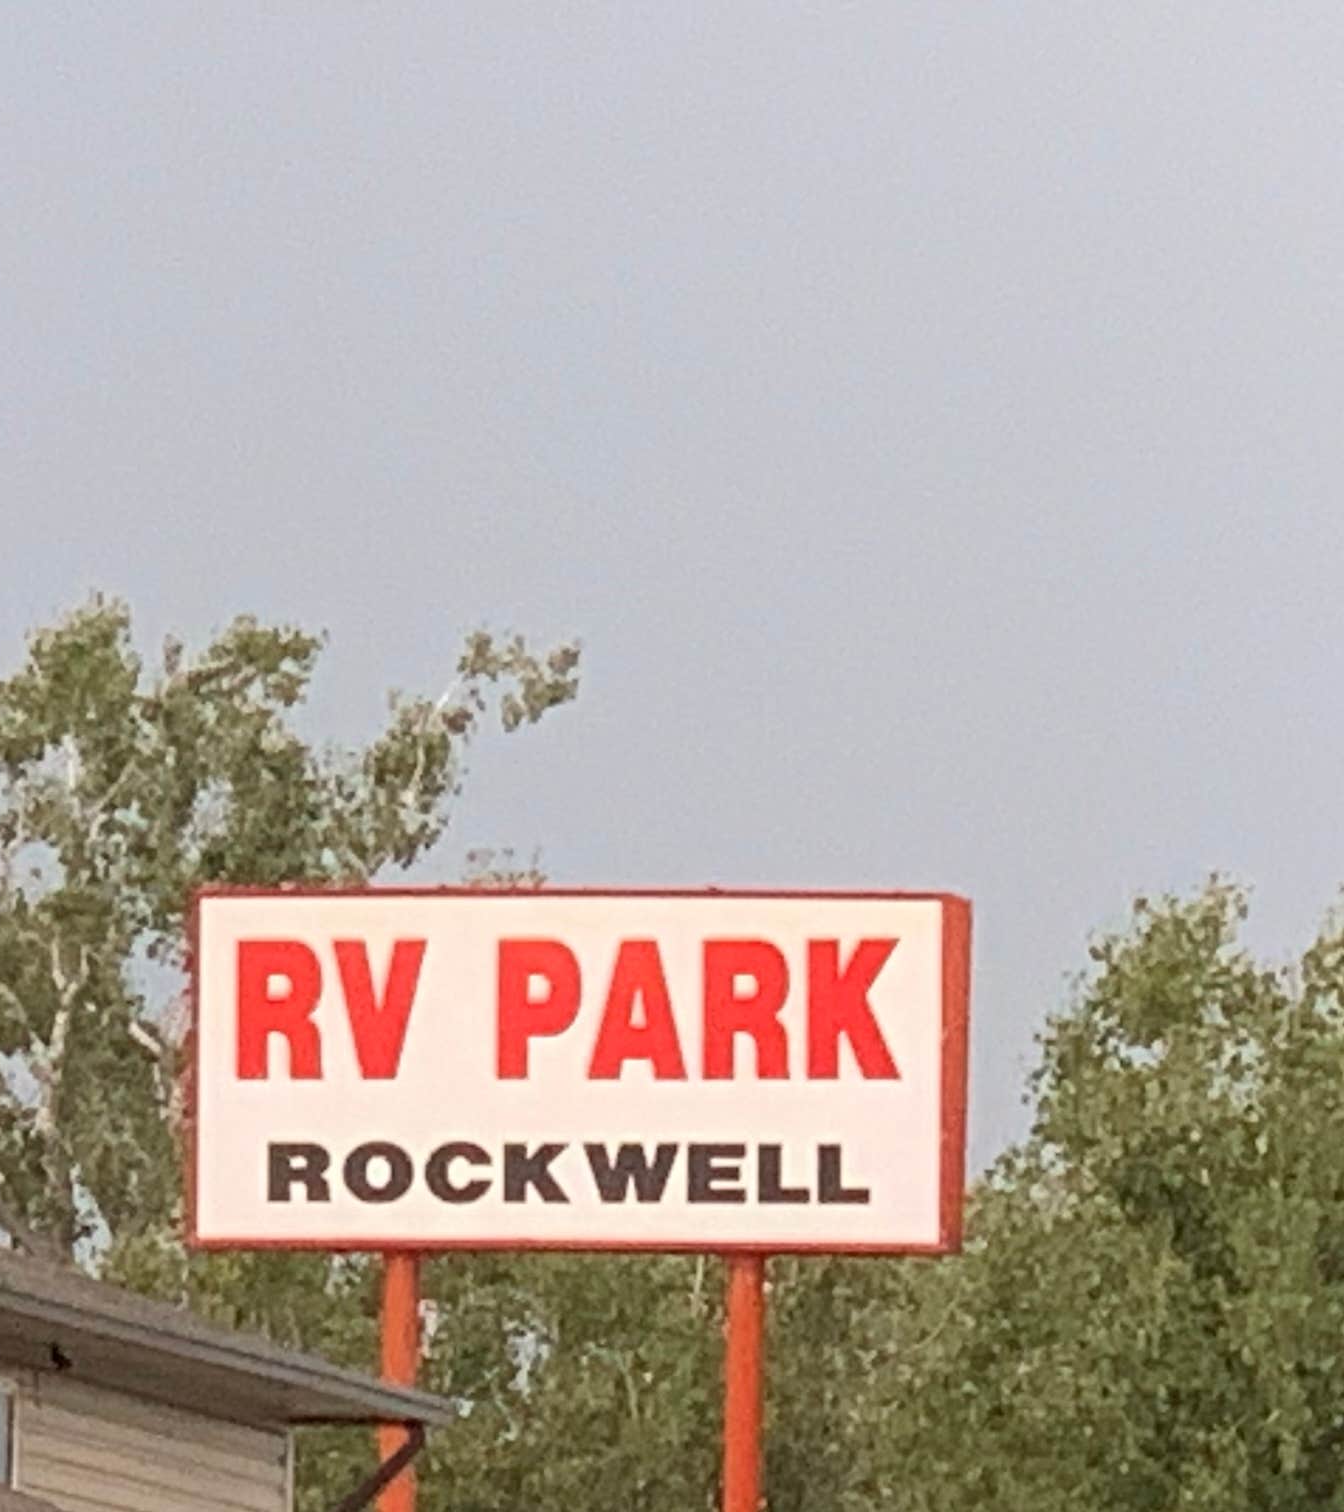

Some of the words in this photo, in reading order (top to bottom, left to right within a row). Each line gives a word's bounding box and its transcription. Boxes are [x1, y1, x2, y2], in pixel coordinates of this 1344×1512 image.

[235, 938, 427, 1080] RV
[495, 937, 901, 1080] PARK
[266, 1140, 870, 1204] ROCKWELL
